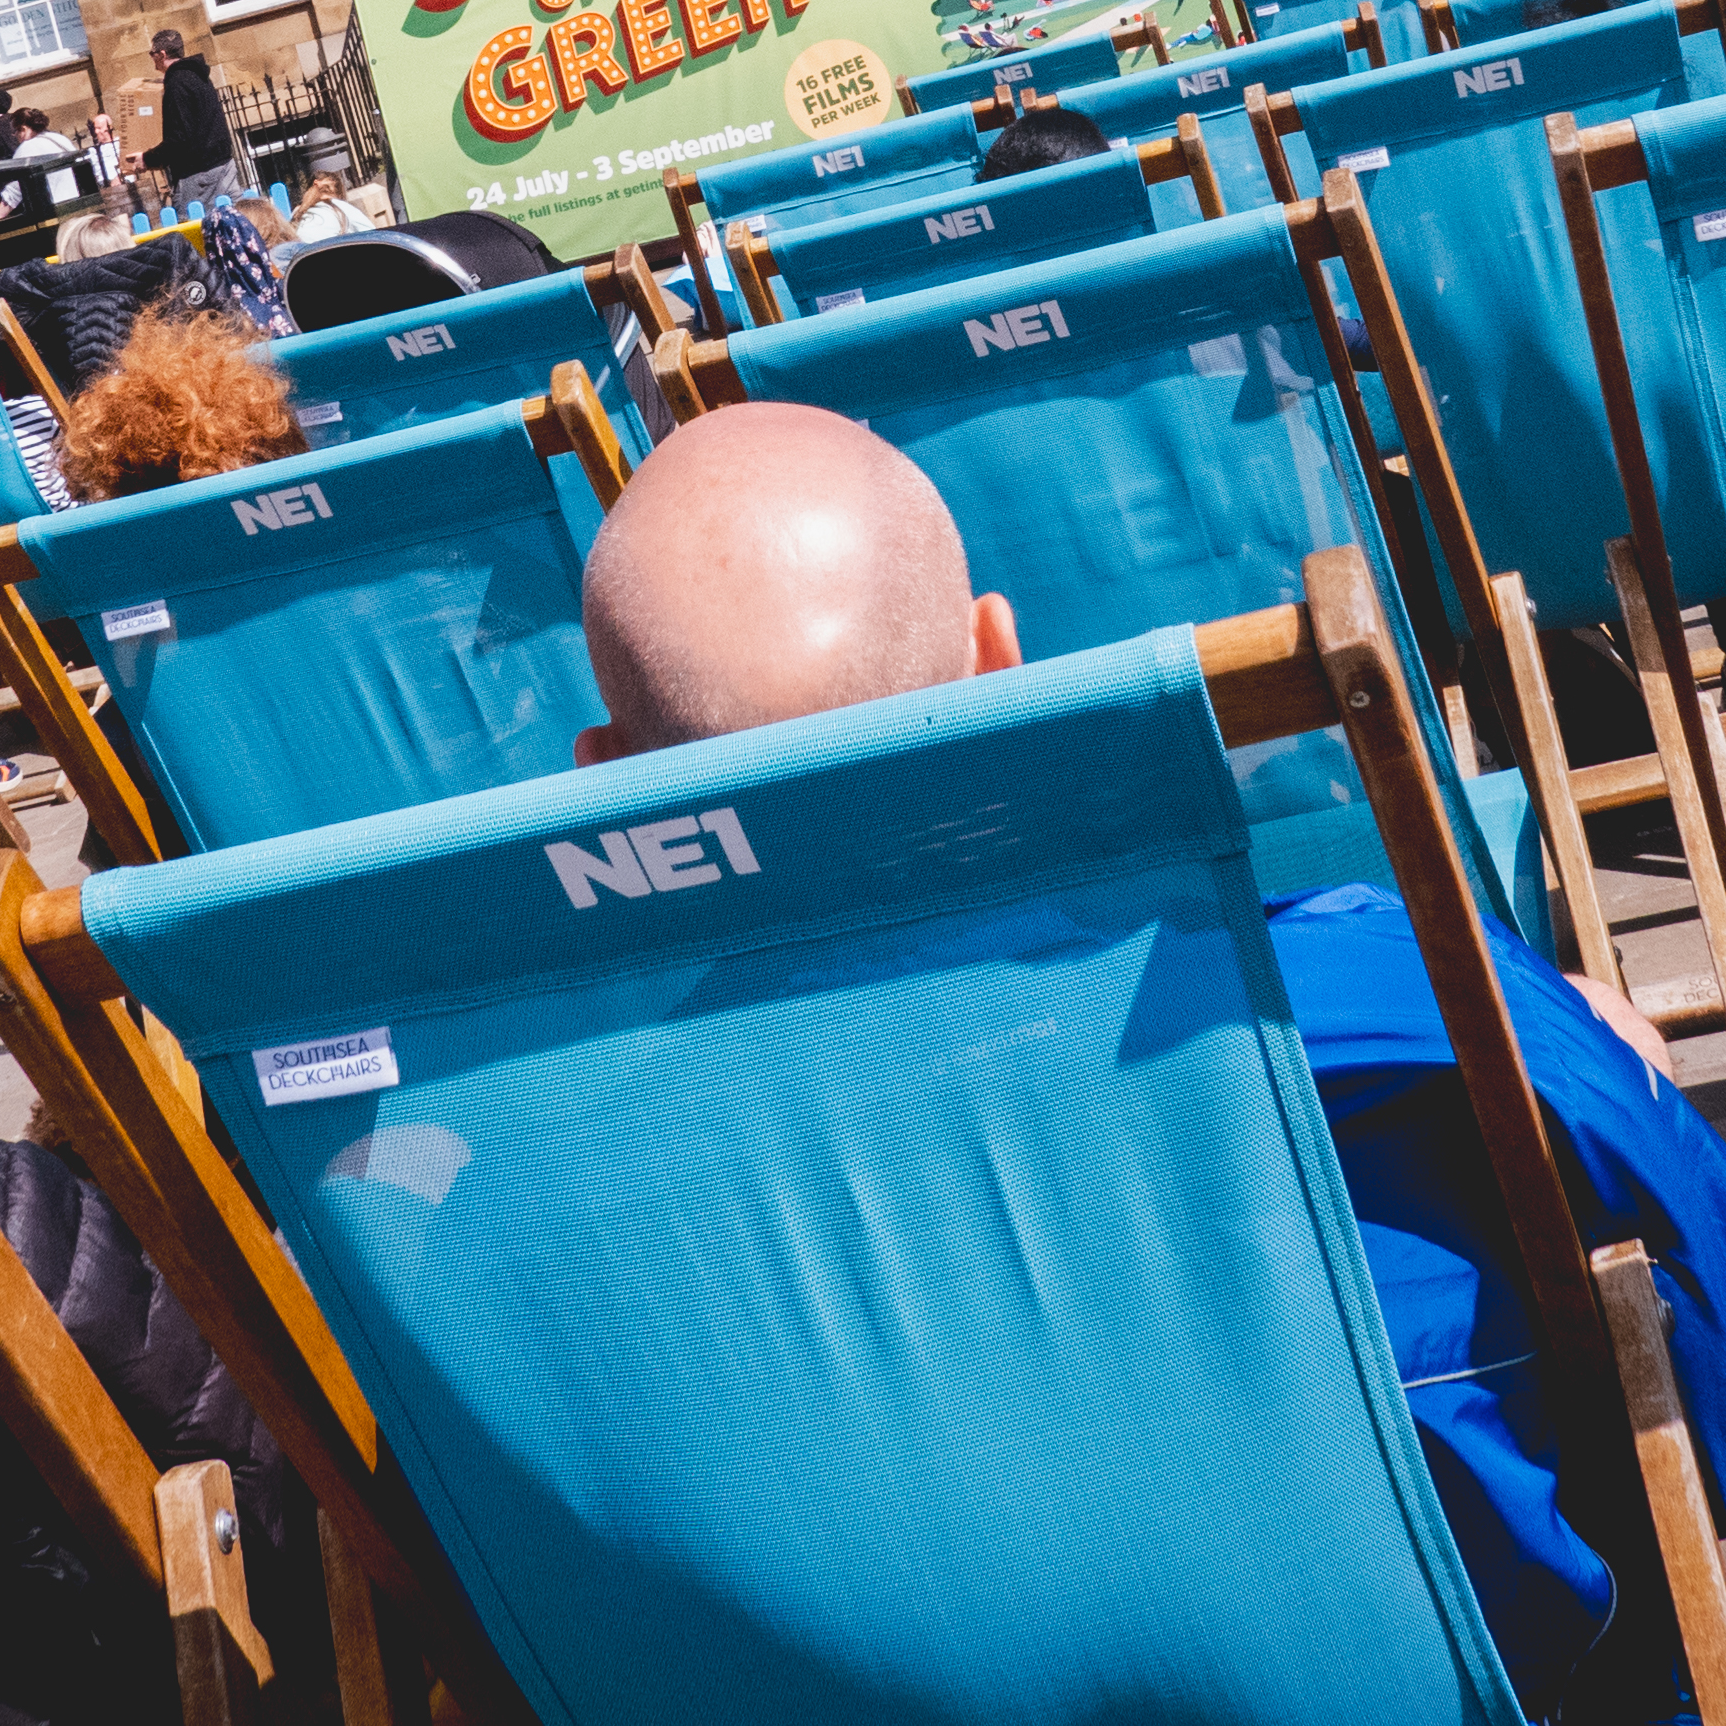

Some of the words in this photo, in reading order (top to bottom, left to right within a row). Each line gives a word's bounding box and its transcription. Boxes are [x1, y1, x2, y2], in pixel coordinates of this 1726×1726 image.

[796, 75, 818, 93] 16
[821, 55, 867, 84] FREE
[993, 61, 1033, 85] NE1
[1177, 66, 1230, 99] NE1
[1454, 58, 1524, 98] NE1
[802, 72, 874, 115] FILMS
[811, 110, 839, 129] PER
[840, 92, 881, 116] WEEK
[467, 182, 506, 210] 24
[513, 170, 569, 201] July
[576, 171, 588, 180] -
[592, 156, 614, 181] 3
[618, 120, 774, 174] September
[811, 146, 866, 177] NE1
[528, 202, 551, 220] full
[554, 193, 602, 218] listings
[606, 189, 619, 201] at
[924, 205, 994, 244] NE1
[823, 292, 857, 304] SOUTHSEA
[386, 324, 456, 361] NE1
[963, 300, 1070, 357] NE1
[231, 483, 333, 535] NE1
[110, 614, 162, 633] DECKCHAIRS
[111, 605, 157, 622] SOUTHSEA
[545, 808, 760, 908] NE1
[273, 1037, 370, 1069] SOUTHSEA
[269, 1056, 382, 1091] DECKCHAIRS
